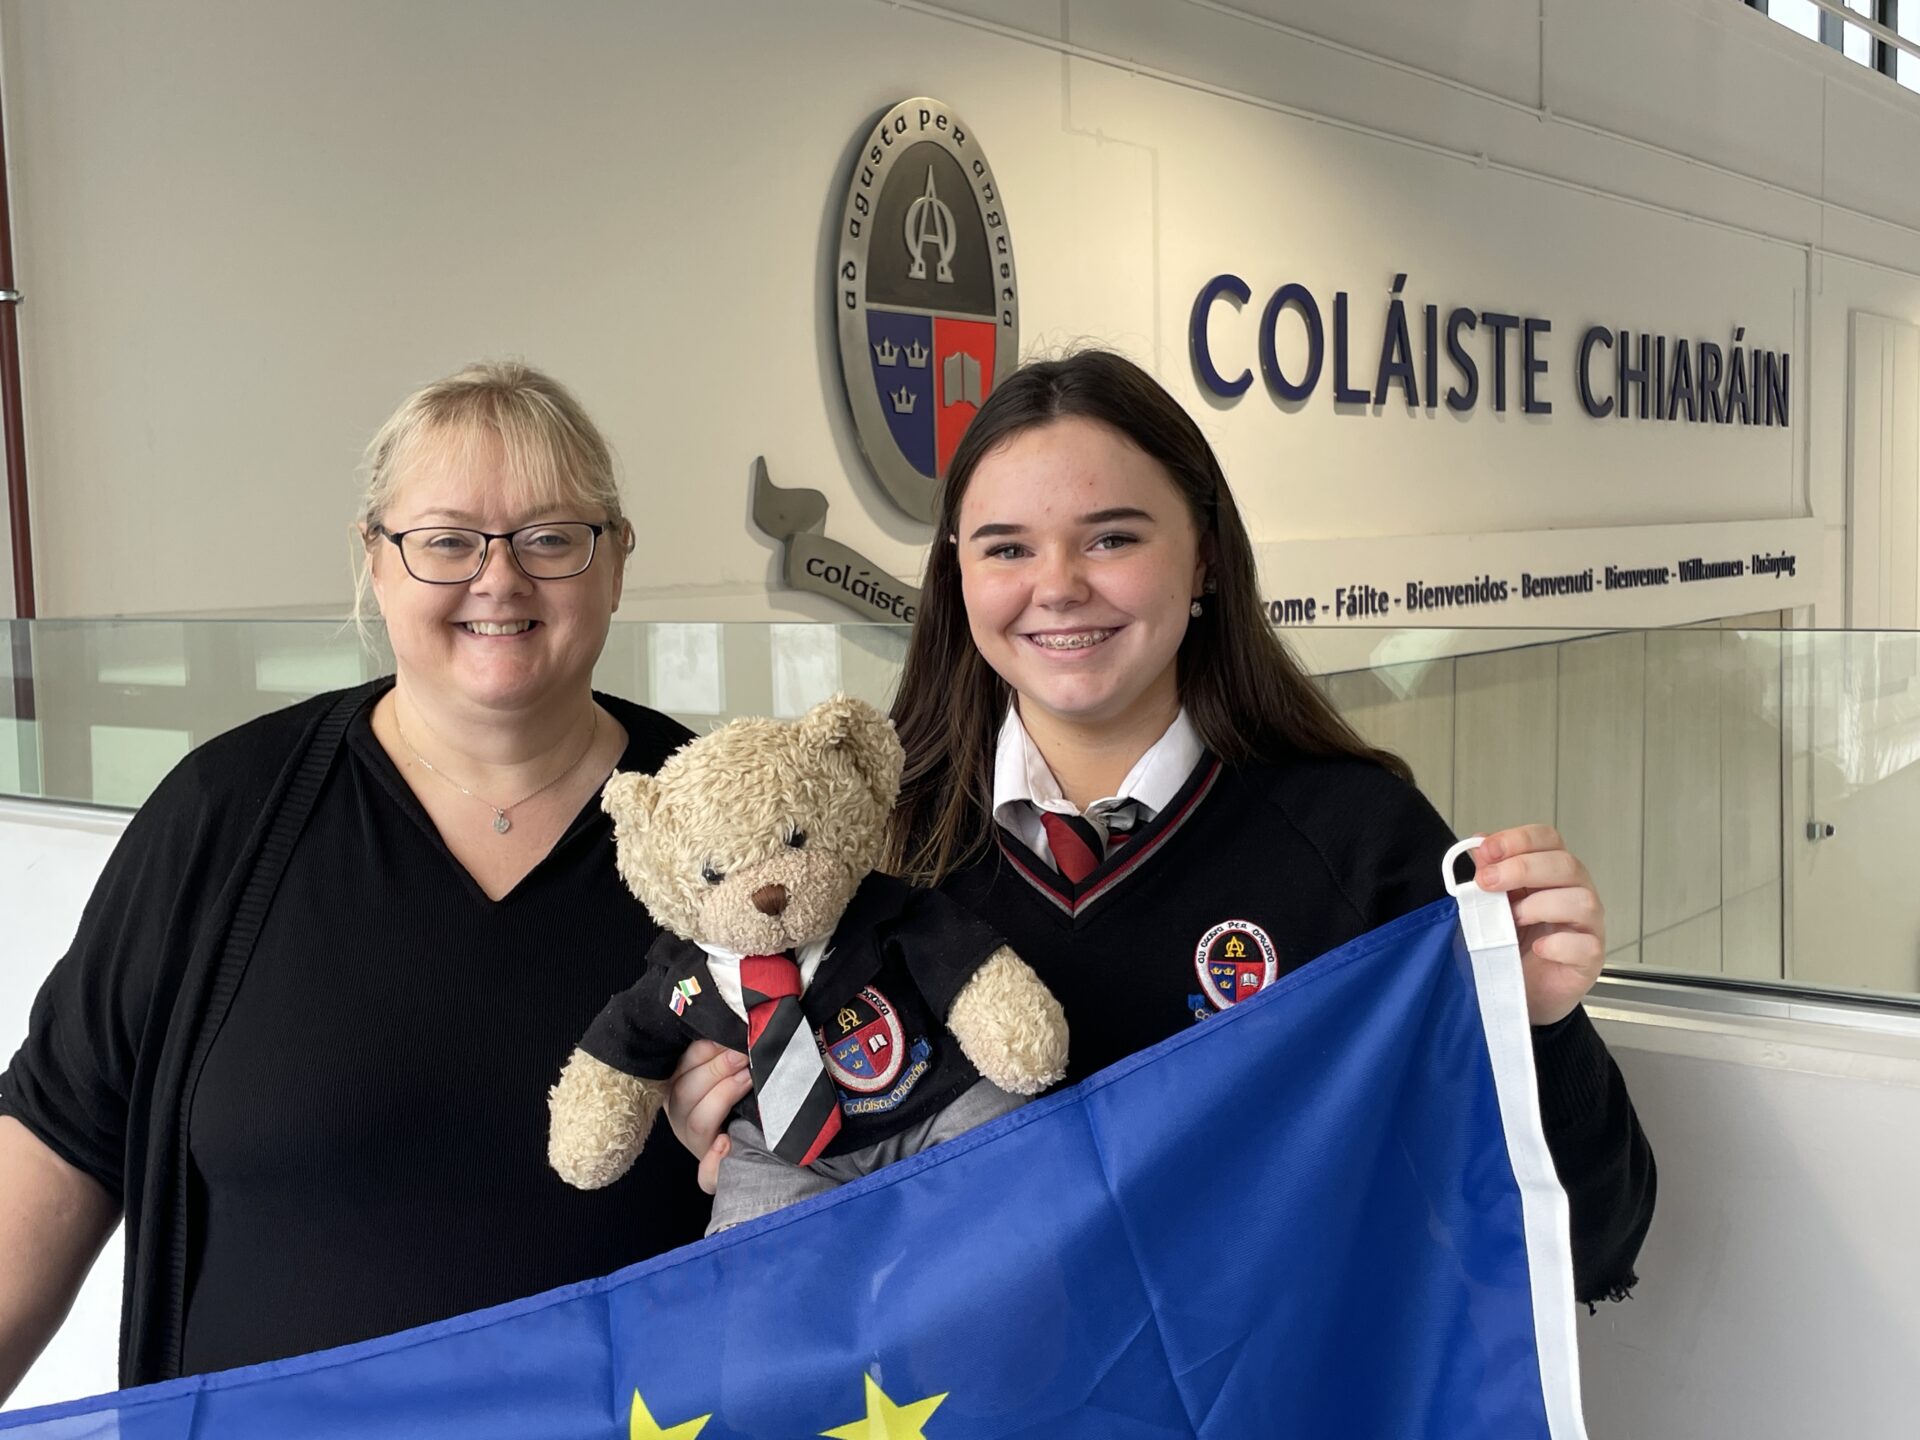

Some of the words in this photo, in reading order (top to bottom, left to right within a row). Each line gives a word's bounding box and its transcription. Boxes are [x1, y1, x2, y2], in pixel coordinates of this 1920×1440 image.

[849, 115, 907, 239] agusta
[972, 159, 1014, 329] angusta
[1189, 273, 1553, 414] COLÁISTE
[1579, 327, 1790, 427] CHIARÁIN
[1335, 585, 1389, 617] Fáilte
[1406, 574, 1508, 611] Bienvenidos
[1521, 569, 1593, 599] Benvenuti
[1604, 565, 1669, 590] Bienvenue
[1678, 557, 1744, 583] Willkommen
